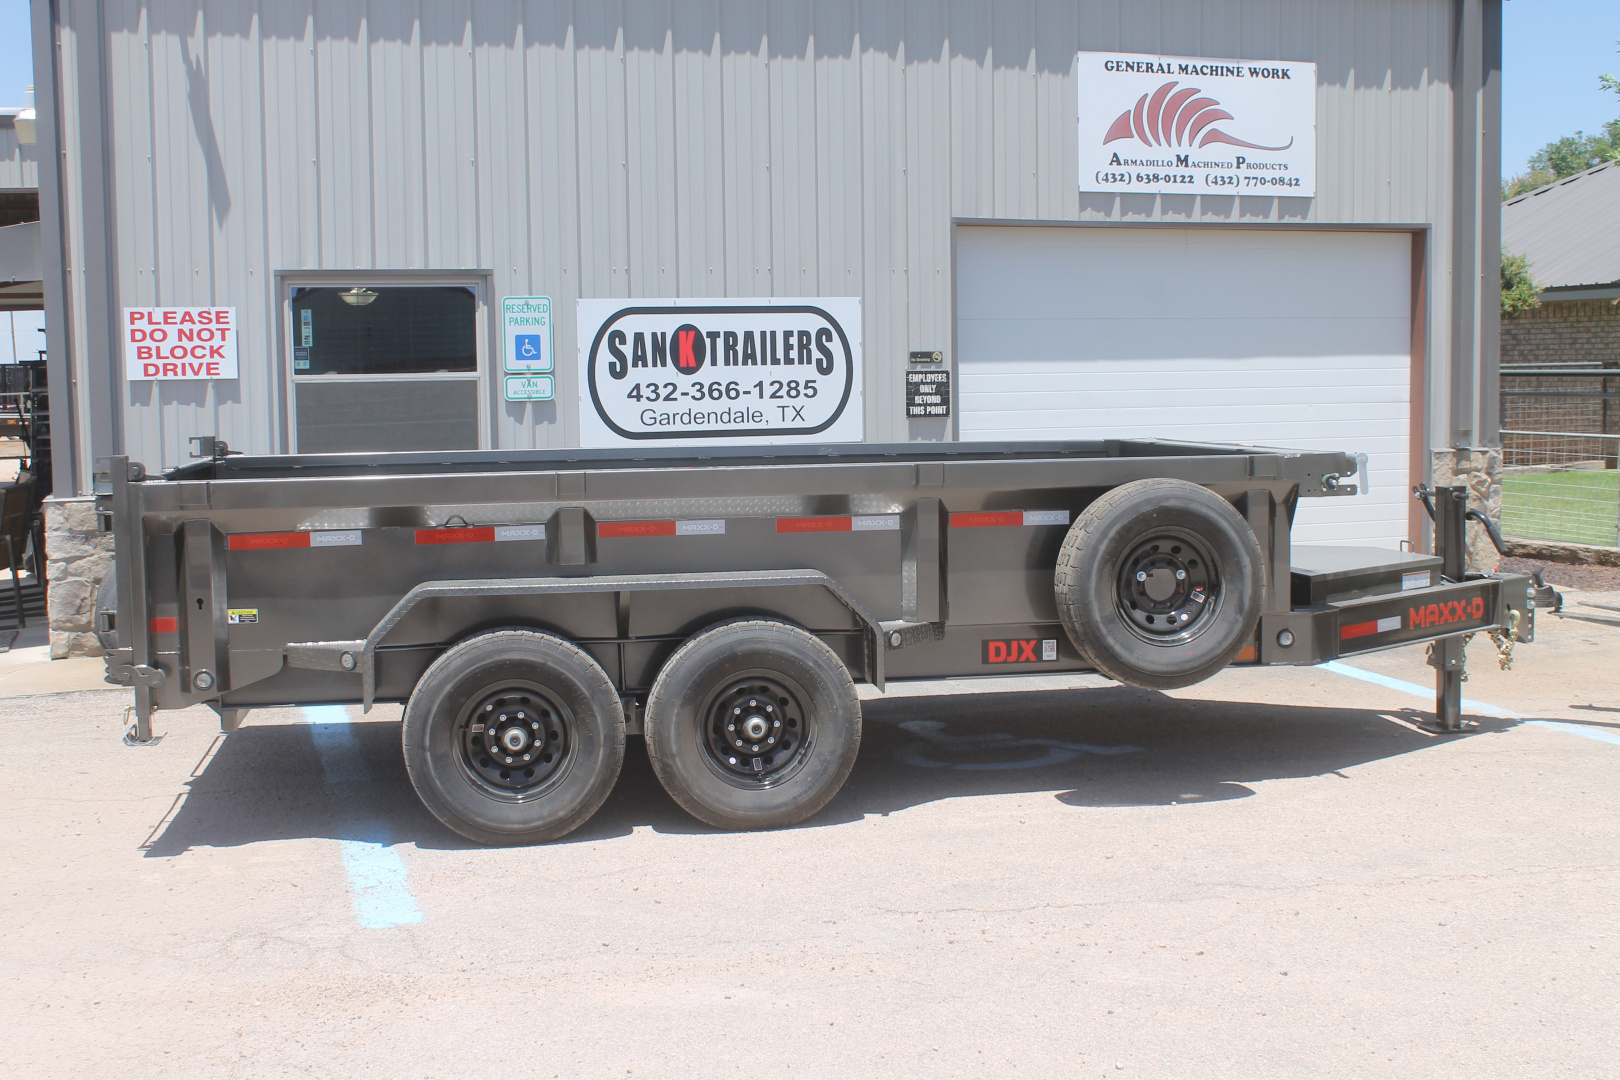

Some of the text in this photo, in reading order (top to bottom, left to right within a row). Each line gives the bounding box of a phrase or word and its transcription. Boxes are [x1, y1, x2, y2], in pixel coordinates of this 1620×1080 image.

[1104, 60, 1291, 79] GENERAL MACHINE WORK
[1095, 170, 1301, 188] (432) 638-0122 (432) 770-0842
[505, 303, 549, 314] RESERVED
[129, 310, 230, 325] PLEASE
[508, 316, 546, 326] PARKING
[130, 327, 231, 343] DO NOT
[136, 345, 226, 360] BLOCK
[706, 327, 835, 376] TRAILERS
[143, 362, 221, 377] DRIVE
[908, 373, 947, 383] EMPLOYEES
[626, 379, 818, 403] 432-366-1285
[920, 384, 937, 393] ONLY
[914, 394, 941, 404] BEYOND
[640, 405, 806, 427] Gardendale, TX
[909, 405, 947, 415] THIS POINT
[682, 523, 719, 531] MAXX-D
[858, 519, 894, 527] MAXX-D
[317, 534, 356, 543] MAXX-D
[501, 529, 539, 537] MAXX-D
[1409, 597, 1484, 630] MAXX-D
[988, 639, 1038, 663] DJX
